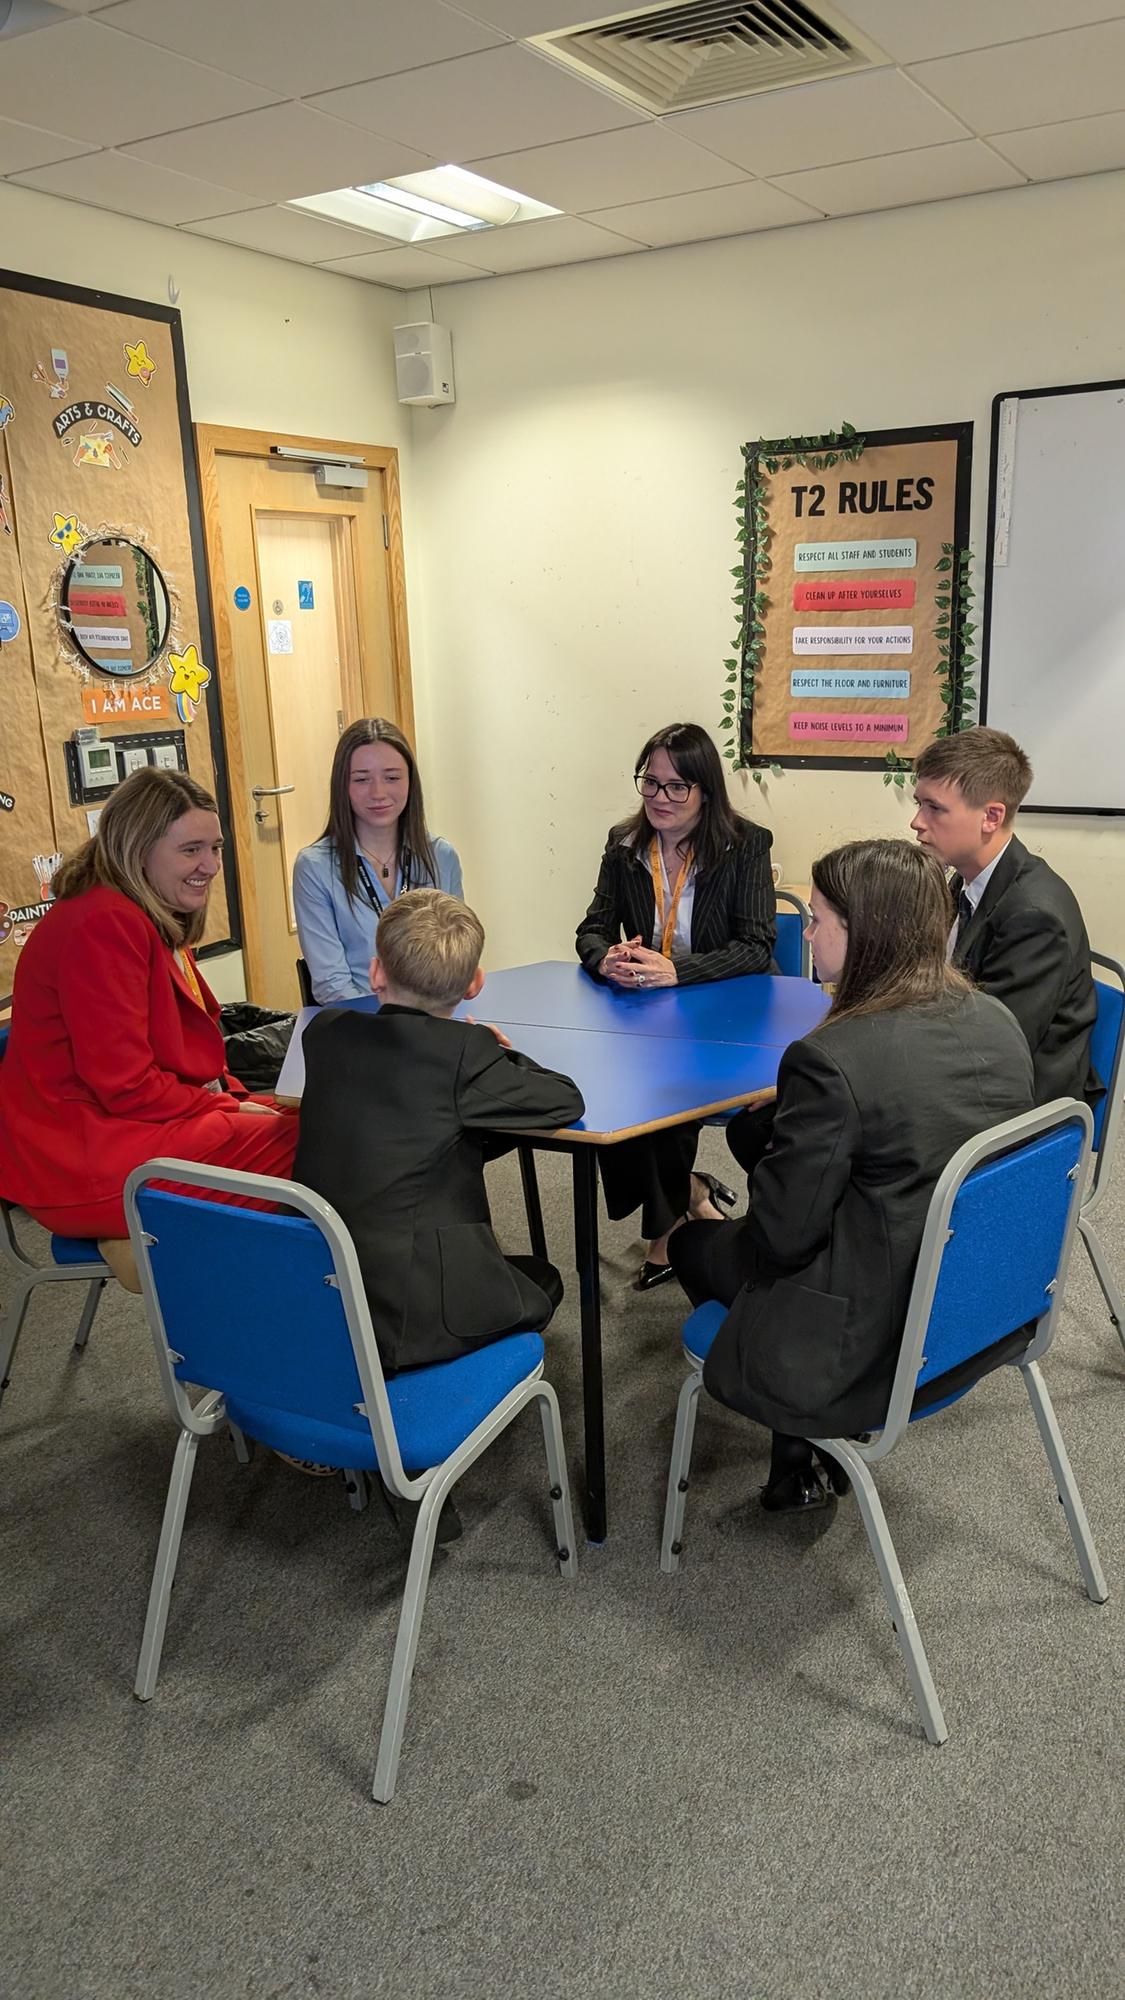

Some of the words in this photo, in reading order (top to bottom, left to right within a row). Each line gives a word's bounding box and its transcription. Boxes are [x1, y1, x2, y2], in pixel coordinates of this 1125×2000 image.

[55, 405, 81, 435] ARTS
[84, 403, 93, 416] &
[97, 404, 141, 444] CRAFTS
[791, 484, 826, 517] T2
[838, 477, 935, 514] RULES
[798, 552, 825, 562] RESPECT
[828, 551, 839, 561] ALL
[841, 550, 860, 560] STAFF
[862, 549, 877, 559] AND
[879, 548, 912, 559] STUDENTS
[805, 591, 826, 601] CLEAN
[827, 591, 836, 600] UP
[838, 590, 858, 600] AFTER
[860, 588, 902, 600] YOURSELVES
[795, 636, 808, 644] TAKE
[810, 636, 853, 645] RESPONSIBILITY
[854, 636, 865, 644] FOR
[867, 636, 883, 644] YOUR
[885, 635, 911, 644] ACTIONS
[792, 678, 819, 688] RESPECT
[821, 678, 833, 688] THE
[835, 678, 856, 688] FLOOR
[857, 679, 871, 688] AND
[873, 679, 908, 689] FURNITURE
[91, 699, 97, 714] I
[103, 699, 126, 713] AM
[131, 696, 162, 711] ACE
[793, 721, 809, 730] KEEP
[810, 721, 829, 731] NOISE
[830, 722, 853, 732] LEVELS
[855, 723, 864, 732] TO
[866, 723, 872, 731] A
[873, 723, 904, 733] MINIMUM
[10, 903, 53, 922] PAINTI
